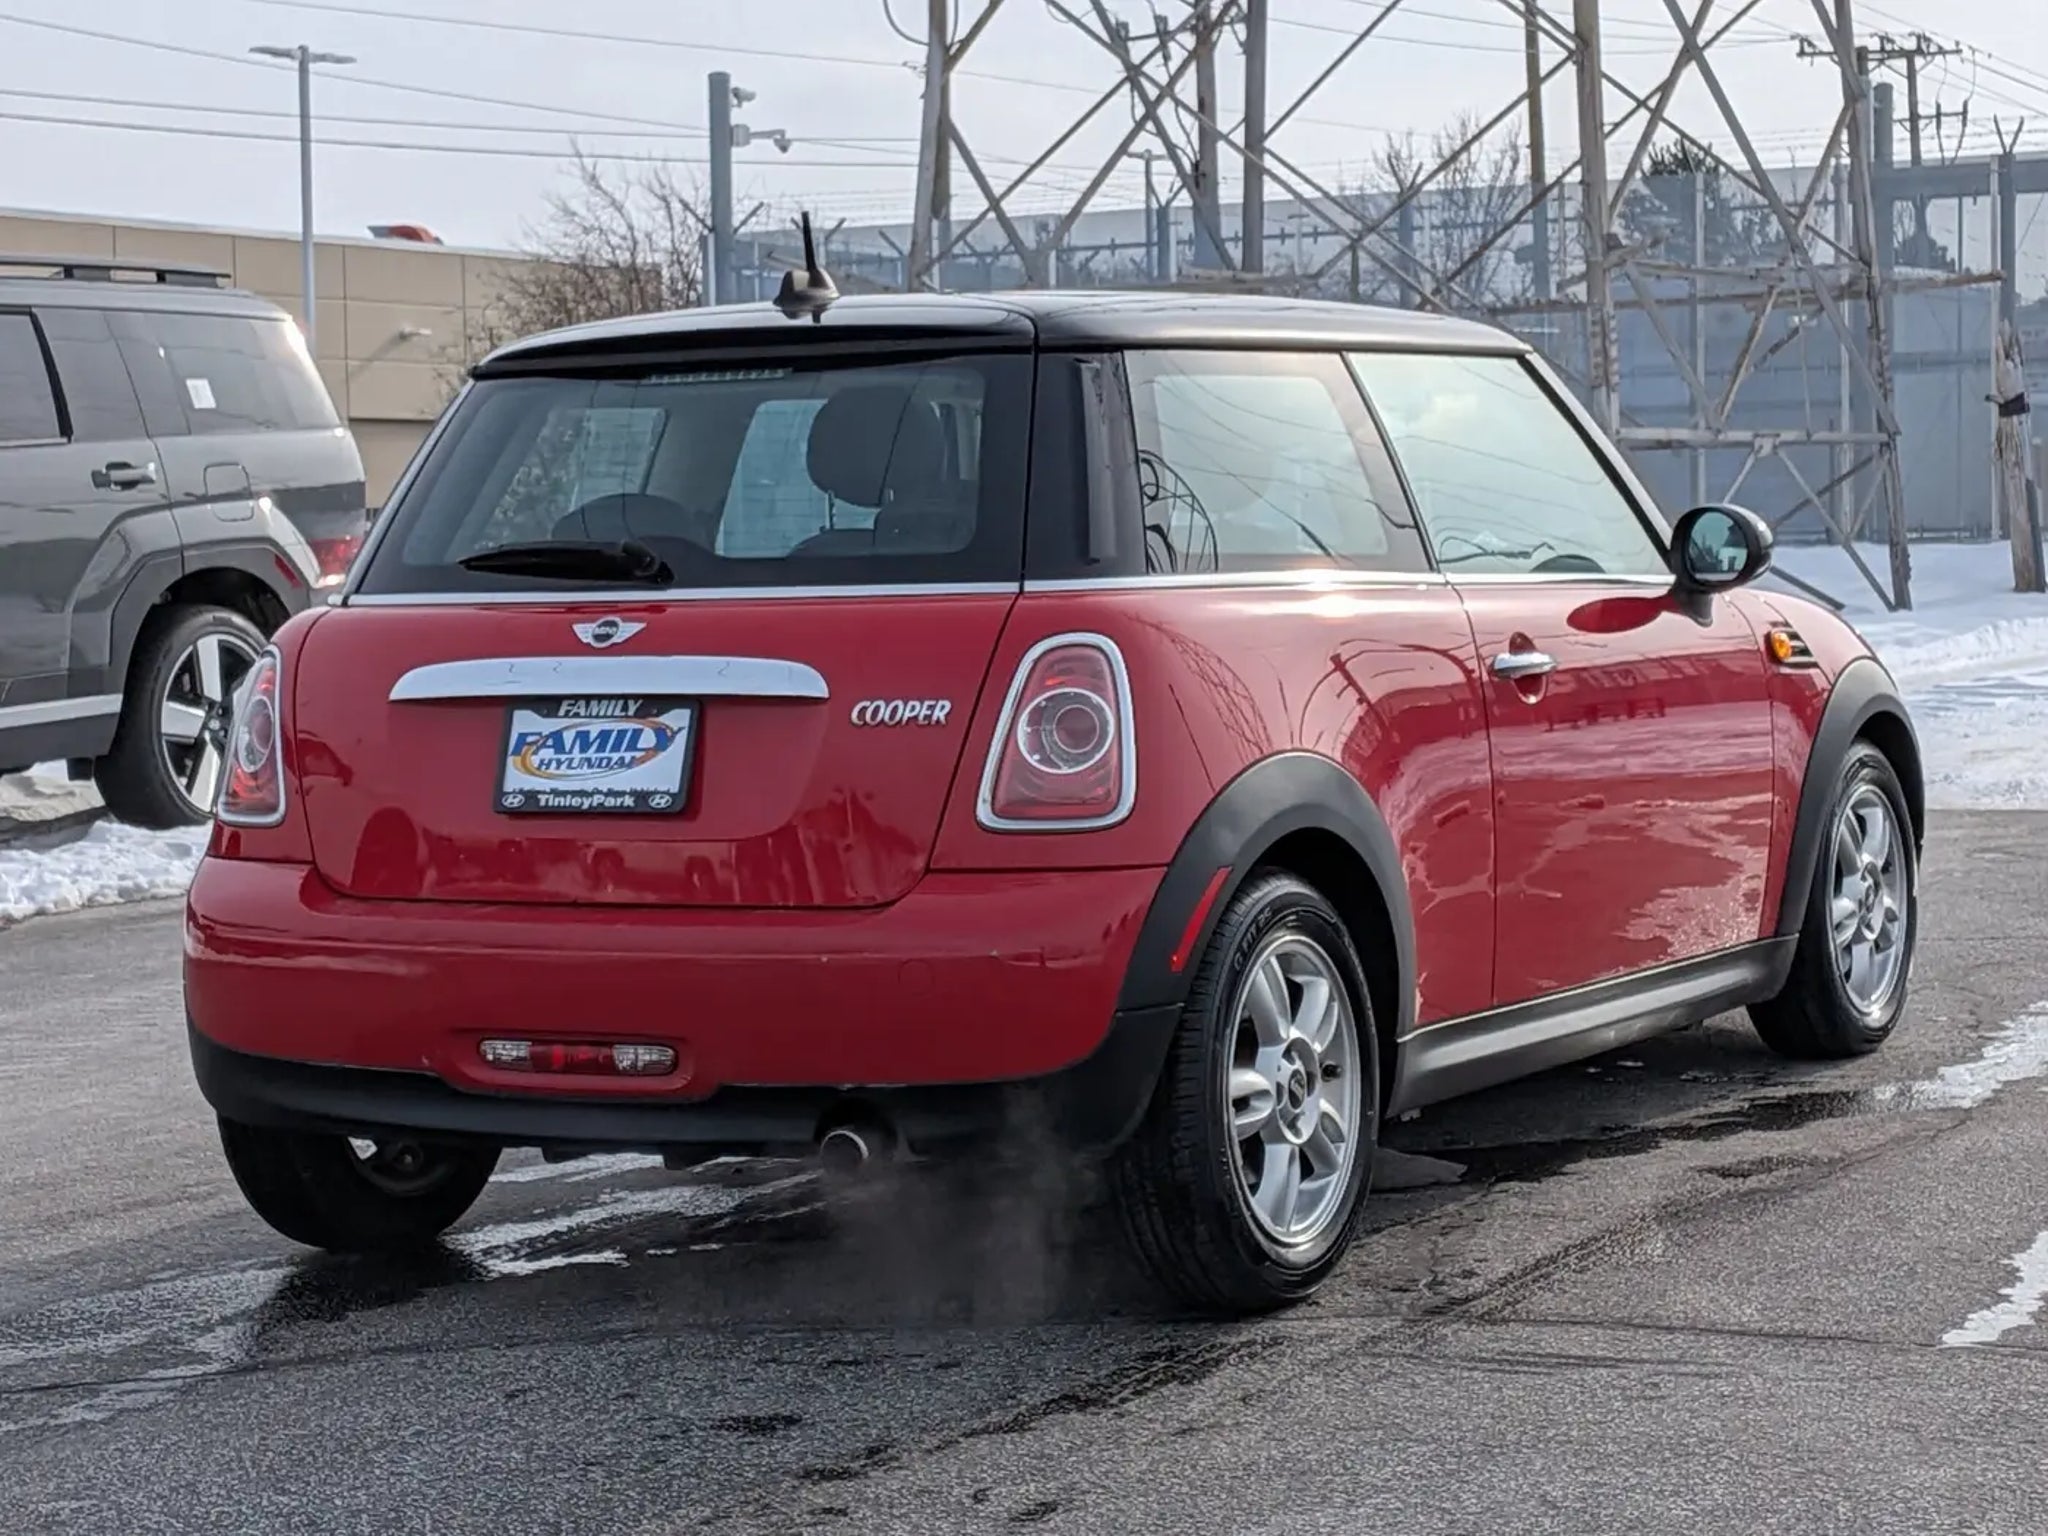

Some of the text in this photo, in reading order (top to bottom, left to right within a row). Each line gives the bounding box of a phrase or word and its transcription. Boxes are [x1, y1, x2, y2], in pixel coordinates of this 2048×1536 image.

[557, 699, 643, 717] FAMILY
[850, 699, 952, 726] COOPER
[510, 726, 686, 756] FAMILY
